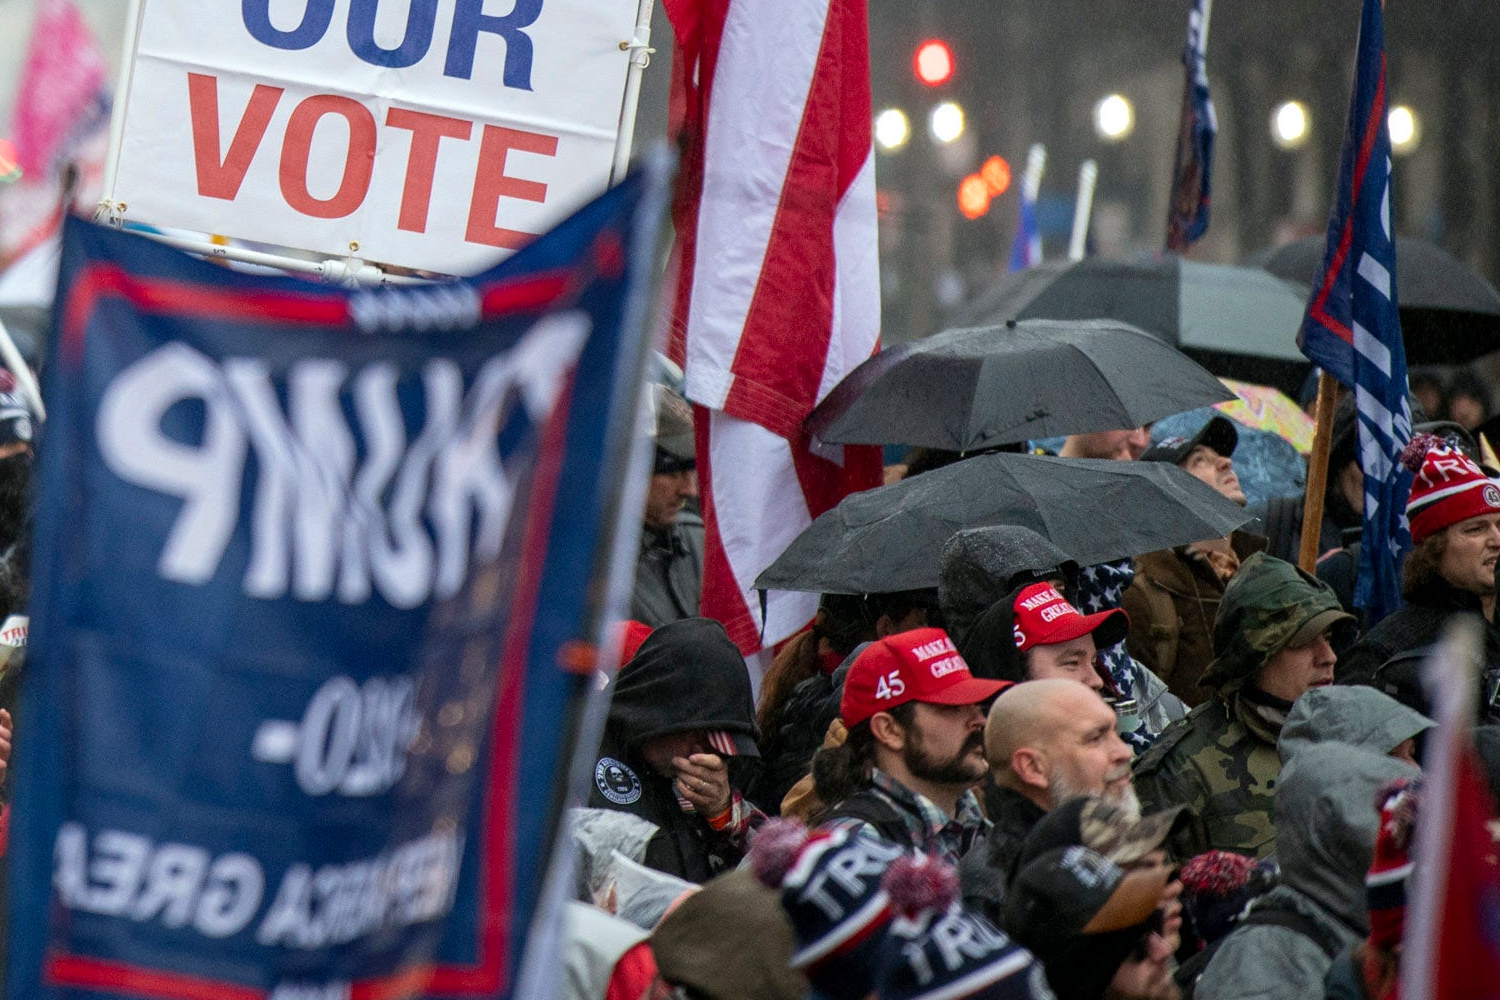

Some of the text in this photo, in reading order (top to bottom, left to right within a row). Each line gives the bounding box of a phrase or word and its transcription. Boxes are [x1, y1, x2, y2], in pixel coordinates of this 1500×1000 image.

[188, 72, 560, 250] VOTE
[1020, 590, 1053, 611] MAKE
[911, 639, 947, 662] MAKE
[875, 670, 905, 701] 45
